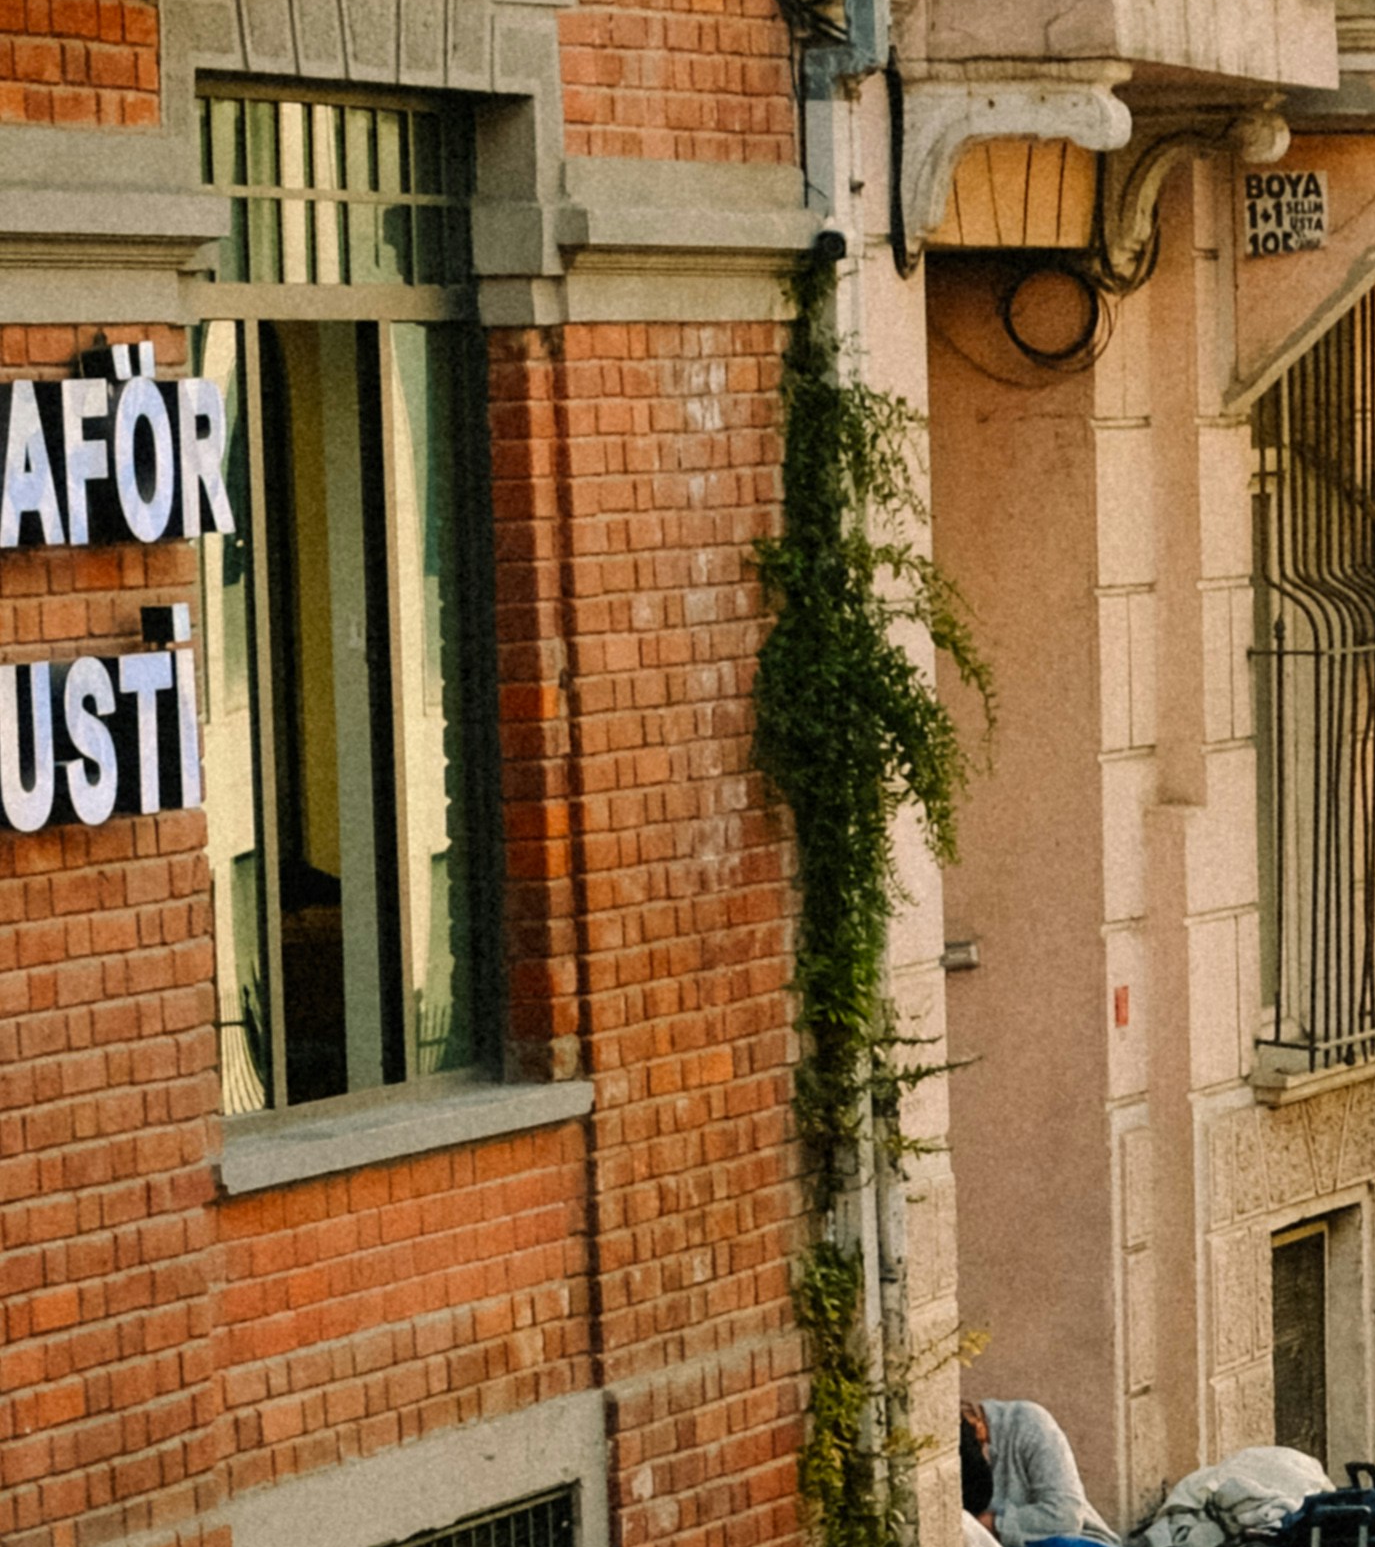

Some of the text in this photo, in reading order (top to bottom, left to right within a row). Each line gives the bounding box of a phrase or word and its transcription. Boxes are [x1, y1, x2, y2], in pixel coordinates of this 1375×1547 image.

[1245, 173, 1322, 199] BOYA
[1247, 200, 1283, 229] 1+1
[0, 341, 235, 548] AFÖR
[0, 602, 202, 833] USTİ
